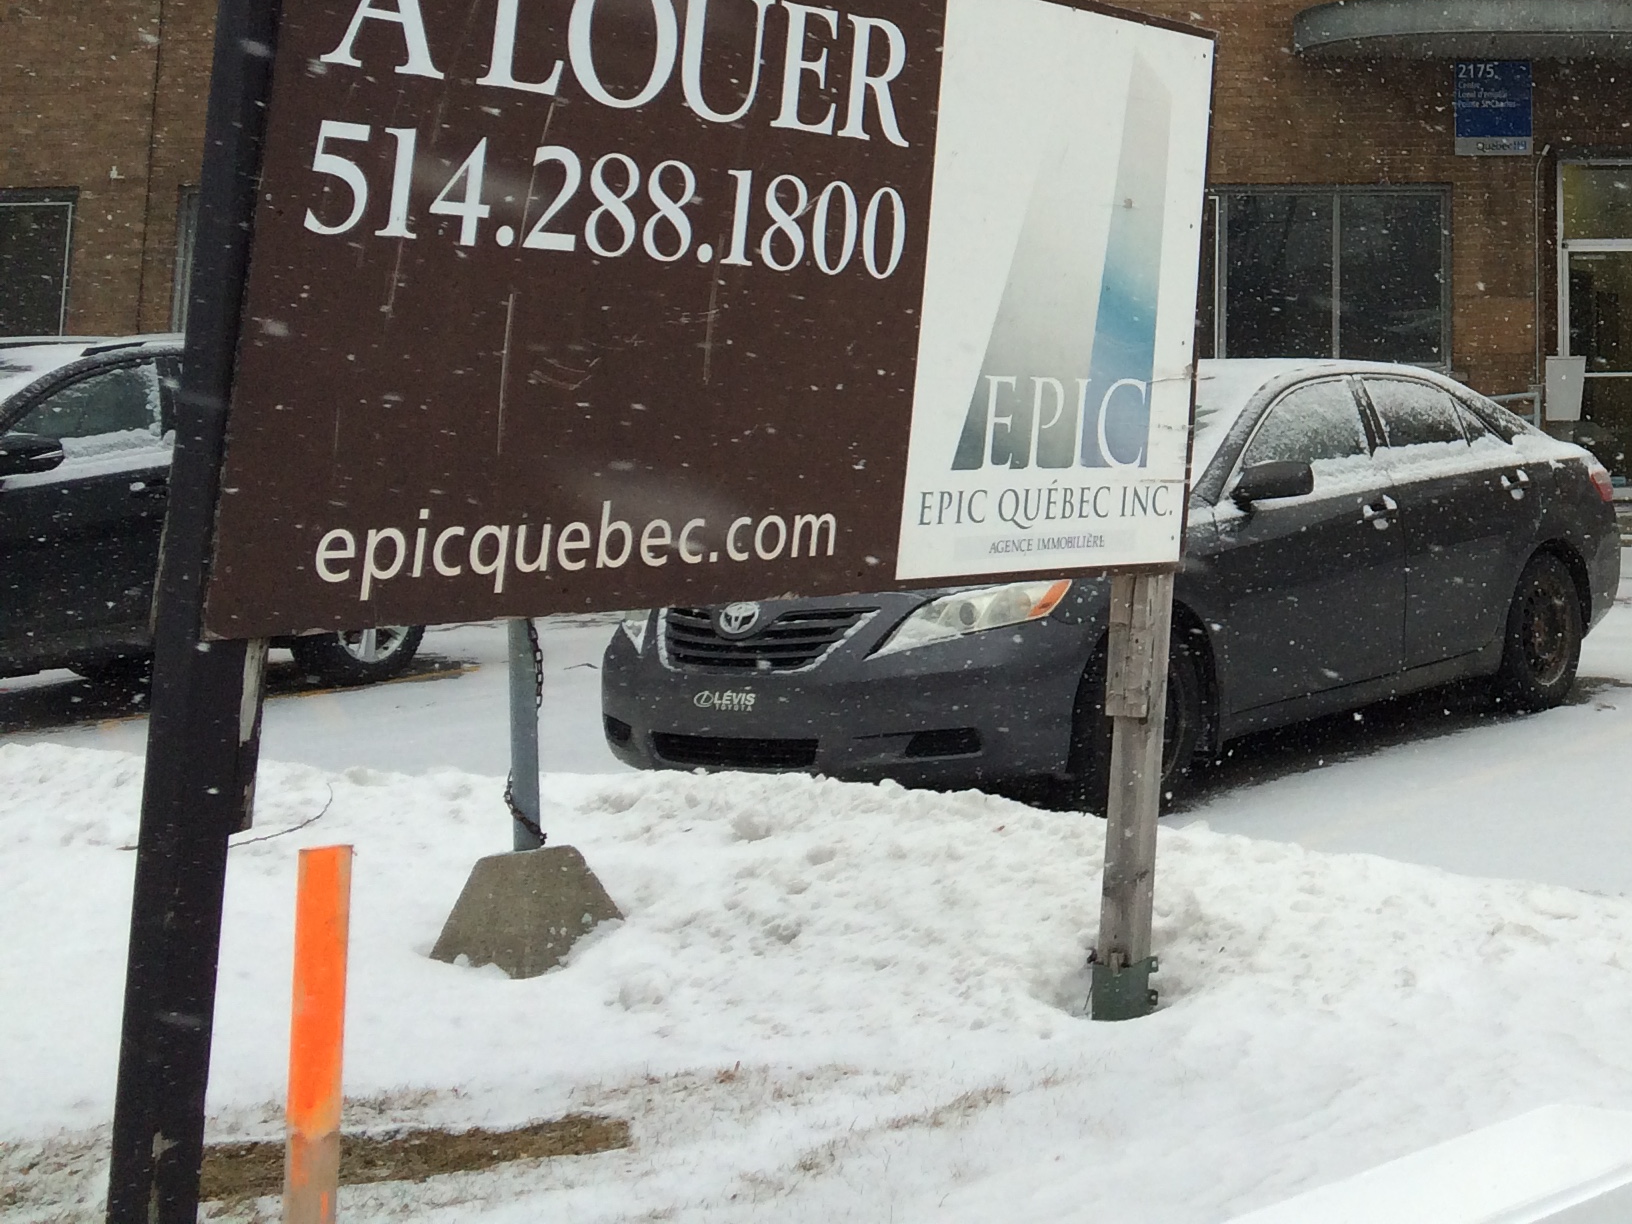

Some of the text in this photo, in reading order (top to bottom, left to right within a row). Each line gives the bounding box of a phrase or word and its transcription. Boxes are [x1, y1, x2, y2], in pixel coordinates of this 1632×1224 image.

[1458, 63, 1495, 78] 2175
[304, 119, 907, 279] 514.288.1800
[979, 375, 1149, 470] EPIC
[918, 479, 1173, 530] EPIC QUÉBEC INC.
[315, 499, 838, 601] epicquebec.com
[713, 690, 756, 706] LÉVIS
[715, 704, 752, 712] TOYOTA
